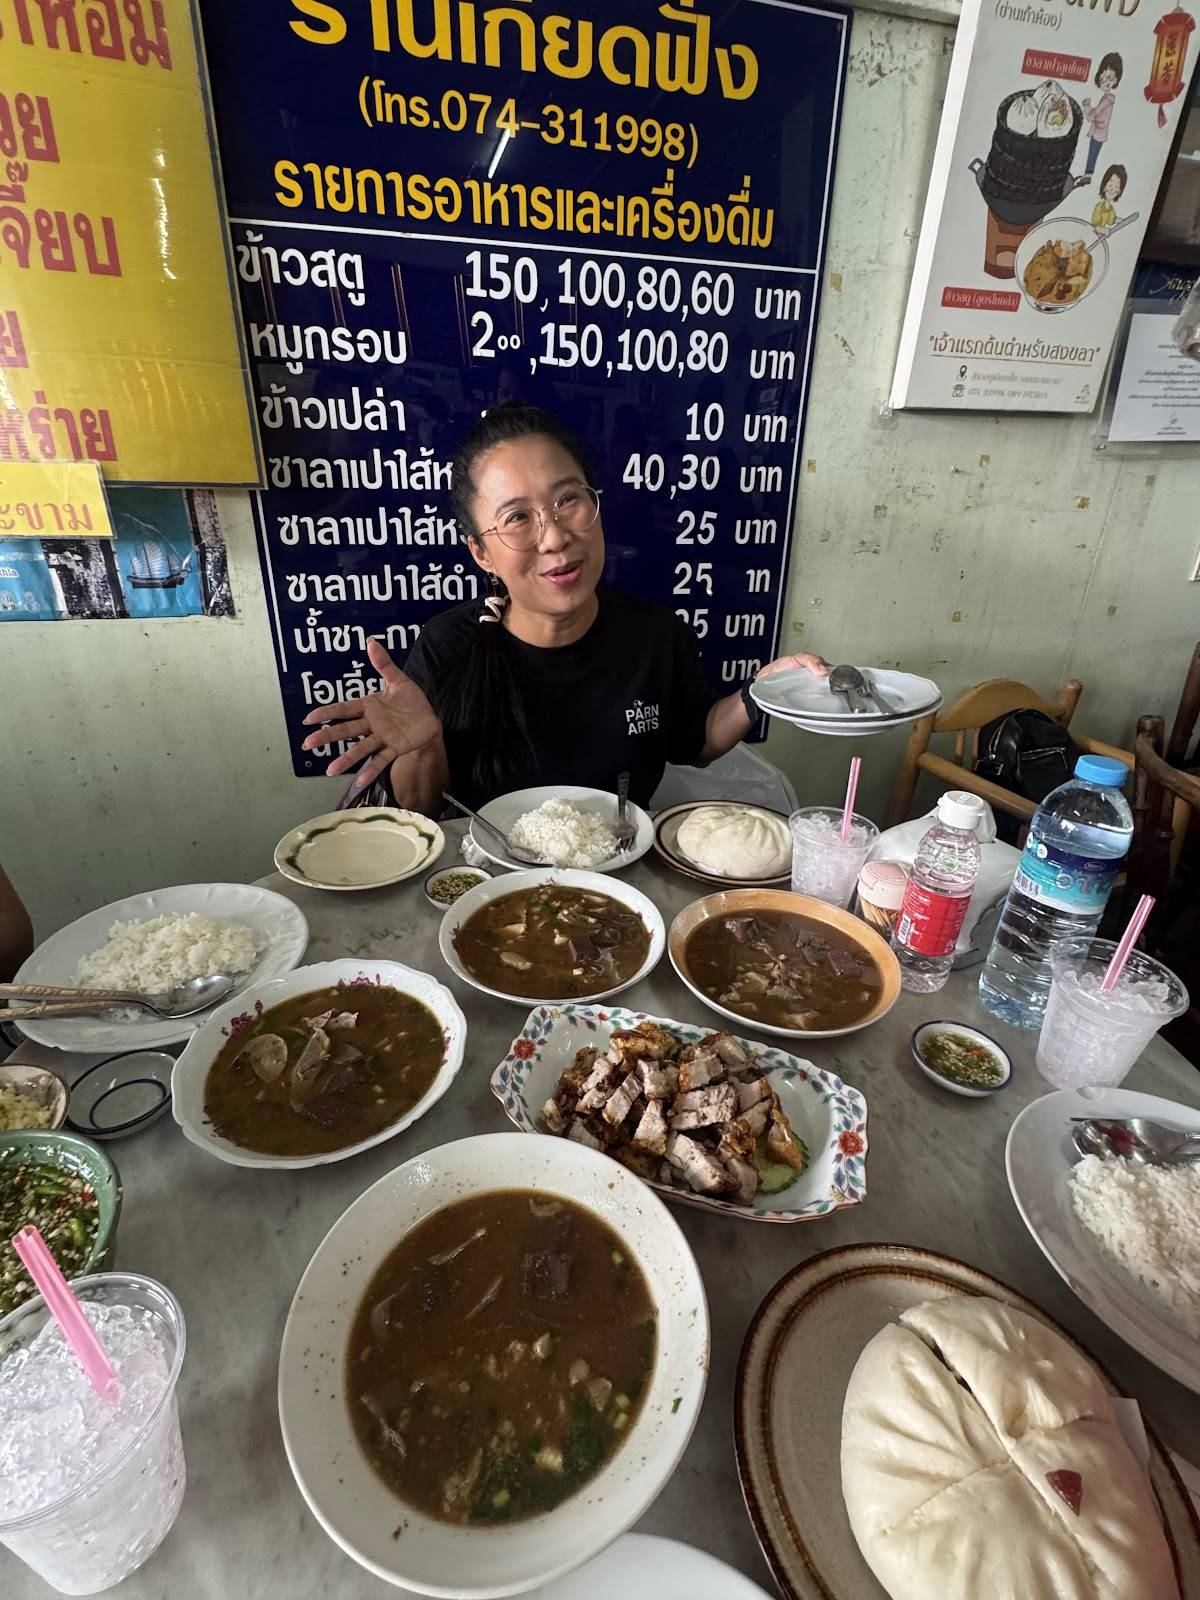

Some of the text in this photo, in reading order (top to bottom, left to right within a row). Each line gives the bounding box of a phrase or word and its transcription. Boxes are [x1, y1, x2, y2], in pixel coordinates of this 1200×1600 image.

[290, 0, 758, 100] รานเกยดฟั่ง
[275, 160, 774, 248] รายการอาหารและเครื่องดื่ม
[237, 230, 365, 307] ข้าวสตู
[755, 287, 801, 321] บาท
[250, 322, 407, 374] หมูกรอบ
[749, 350, 795, 380] บาท
[261, 386, 788, 443] ข้าวเปล่า 10 บาท
[623, 453, 720, 500] 40,30
[740, 466, 782, 493] บาท
[279, 504, 777, 546] ซาลาเปาไส้ห 25 บาท
[286, 562, 478, 602] ซาลาเปาไส้ดำ
[672, 562, 713, 596] 25
[725, 613, 765, 638] บาท
[625, 704, 659, 722] PARN
[628, 717, 659, 735] ARTS
